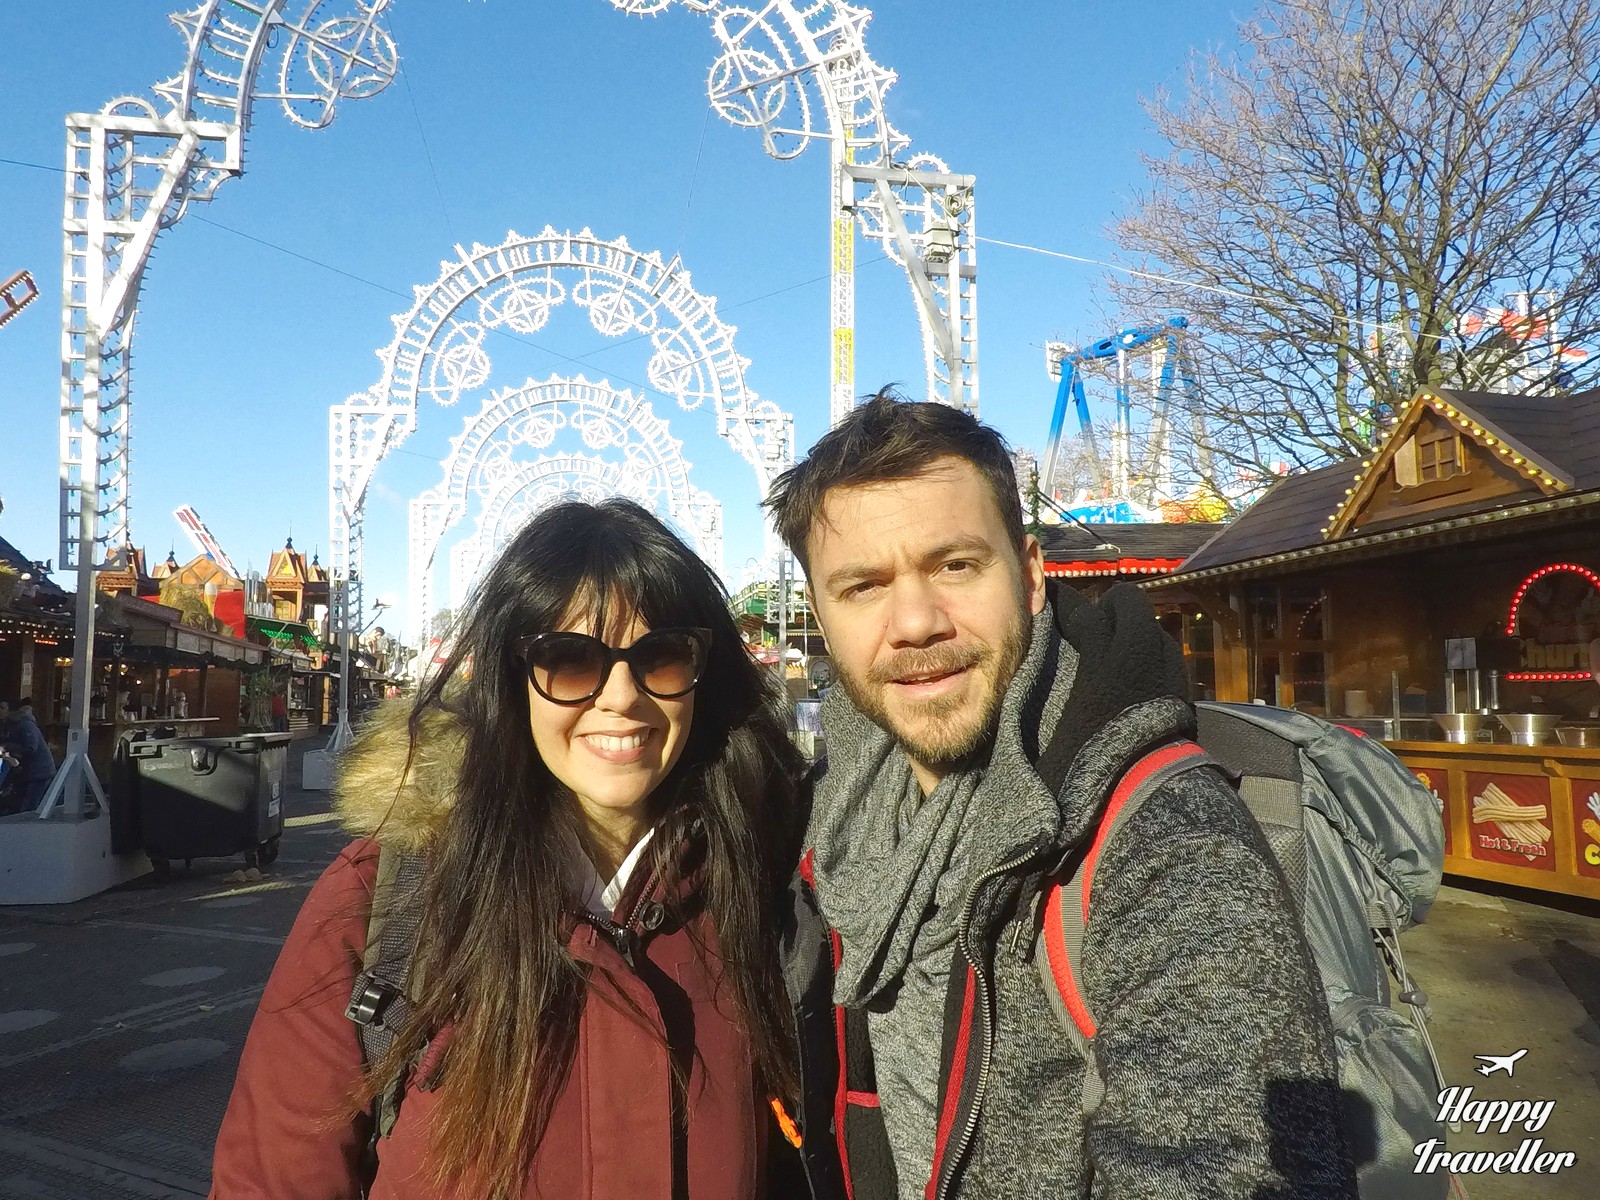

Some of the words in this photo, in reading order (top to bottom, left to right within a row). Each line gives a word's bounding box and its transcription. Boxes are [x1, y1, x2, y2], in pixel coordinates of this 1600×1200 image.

[1478, 835, 1501, 849] Hot
[1501, 838, 1511, 851] &
[1510, 839, 1547, 857] Fresh
